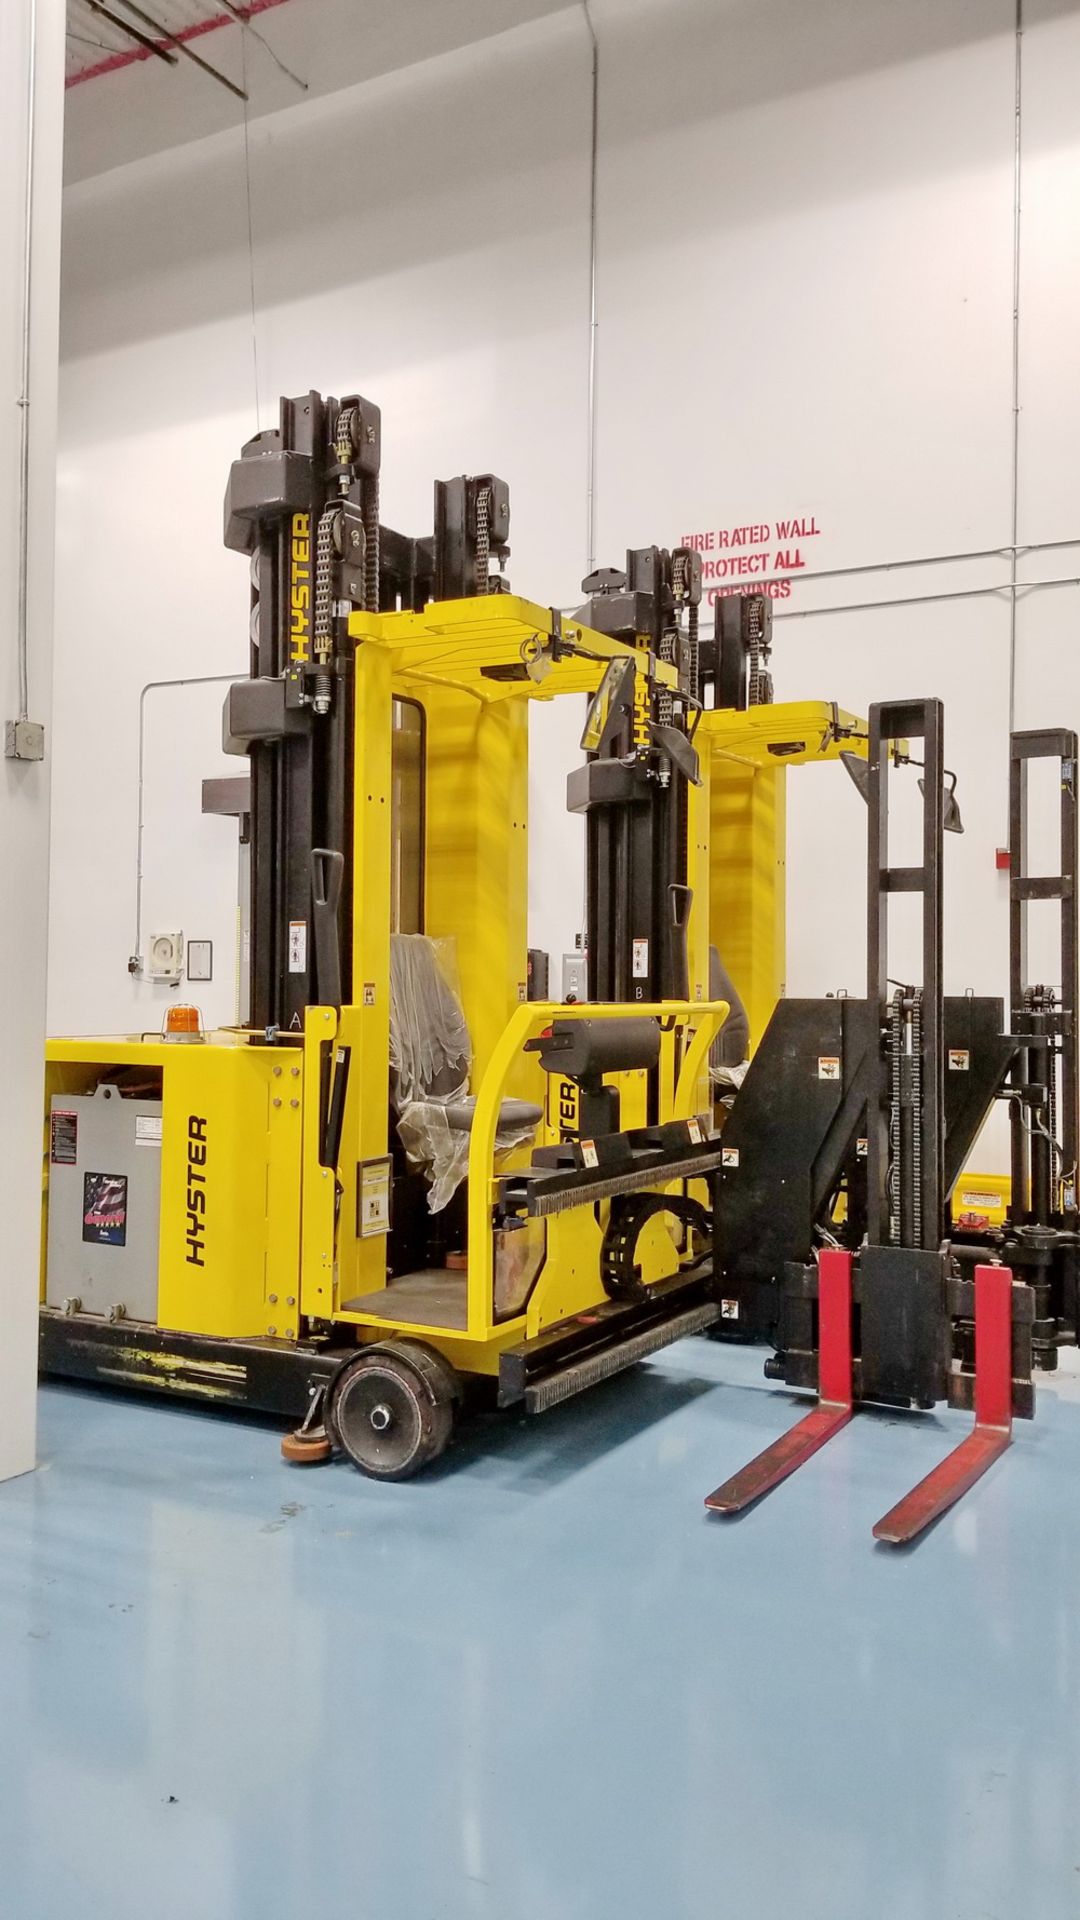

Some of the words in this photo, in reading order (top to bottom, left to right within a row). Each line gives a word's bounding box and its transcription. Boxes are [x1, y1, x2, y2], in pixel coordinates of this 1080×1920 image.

[681, 532, 714, 552] FIRE
[719, 524, 769, 548] RATED
[776, 517, 820, 540] WALL
[774, 549, 805, 570] ALL
[291, 512, 310, 662] HYSTER
[635, 986, 643, 999] B
[289, 1011, 302, 1029] A
[186, 1114, 207, 1267] HYSTER
